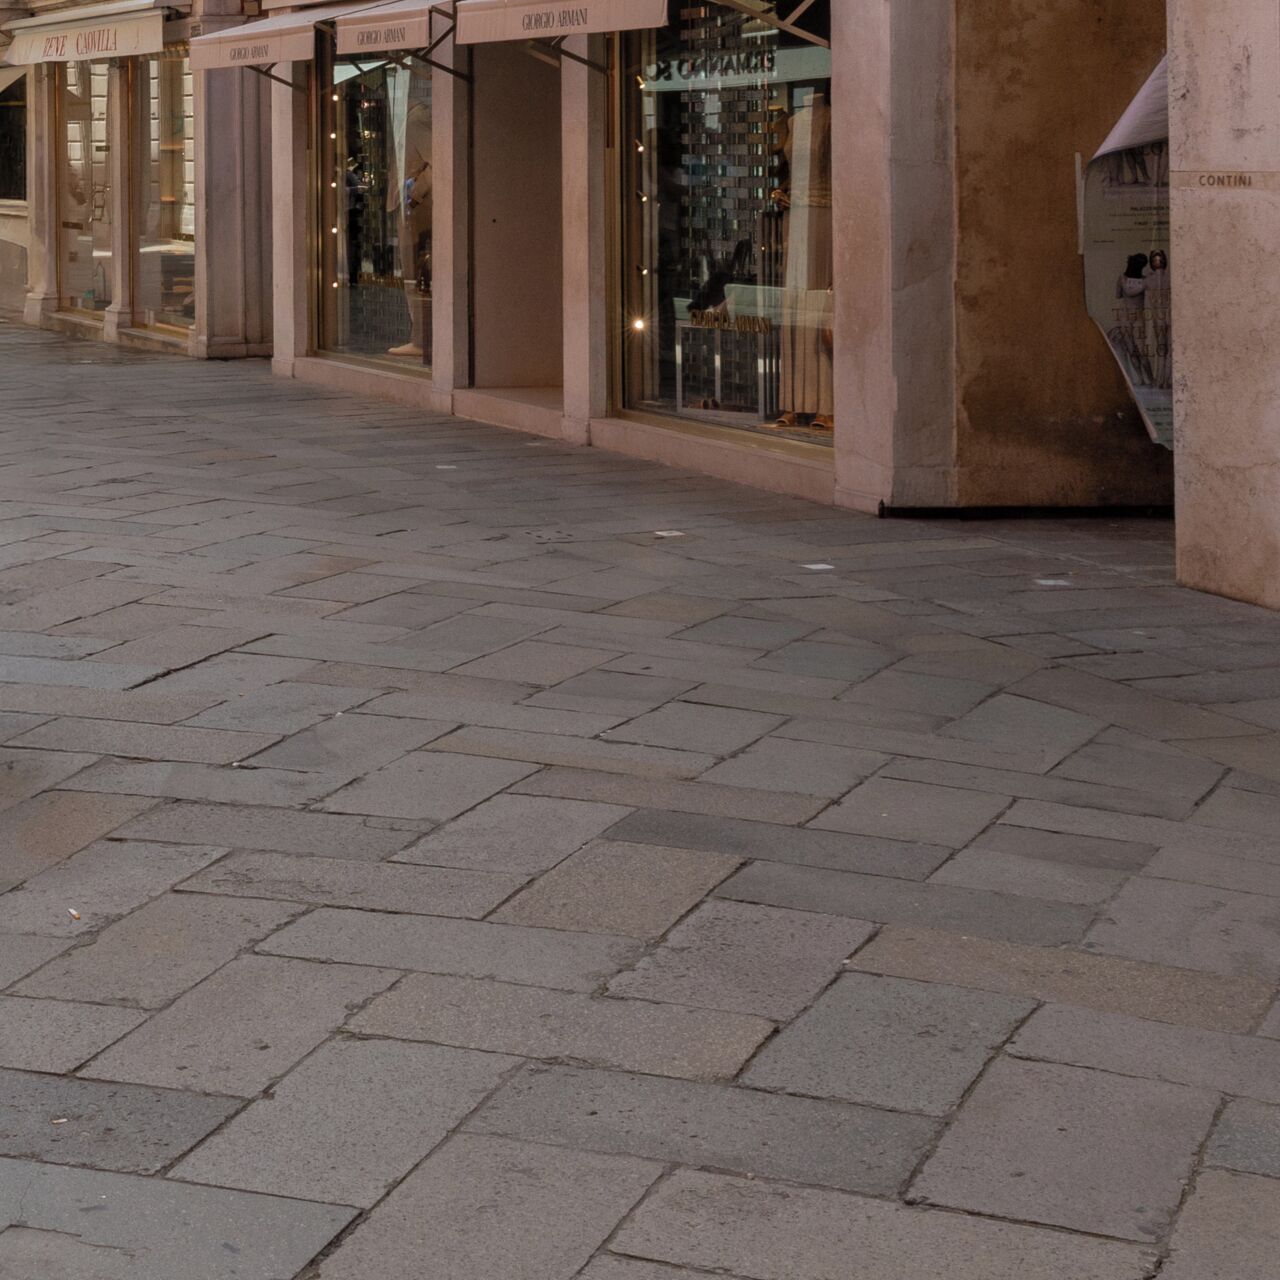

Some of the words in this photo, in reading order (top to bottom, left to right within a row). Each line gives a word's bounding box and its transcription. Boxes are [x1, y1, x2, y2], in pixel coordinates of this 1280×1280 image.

[522, 11, 555, 31] GIORGIO
[556, 7, 588, 27] ARMANI
[1199, 175, 1252, 187] CONTINI
